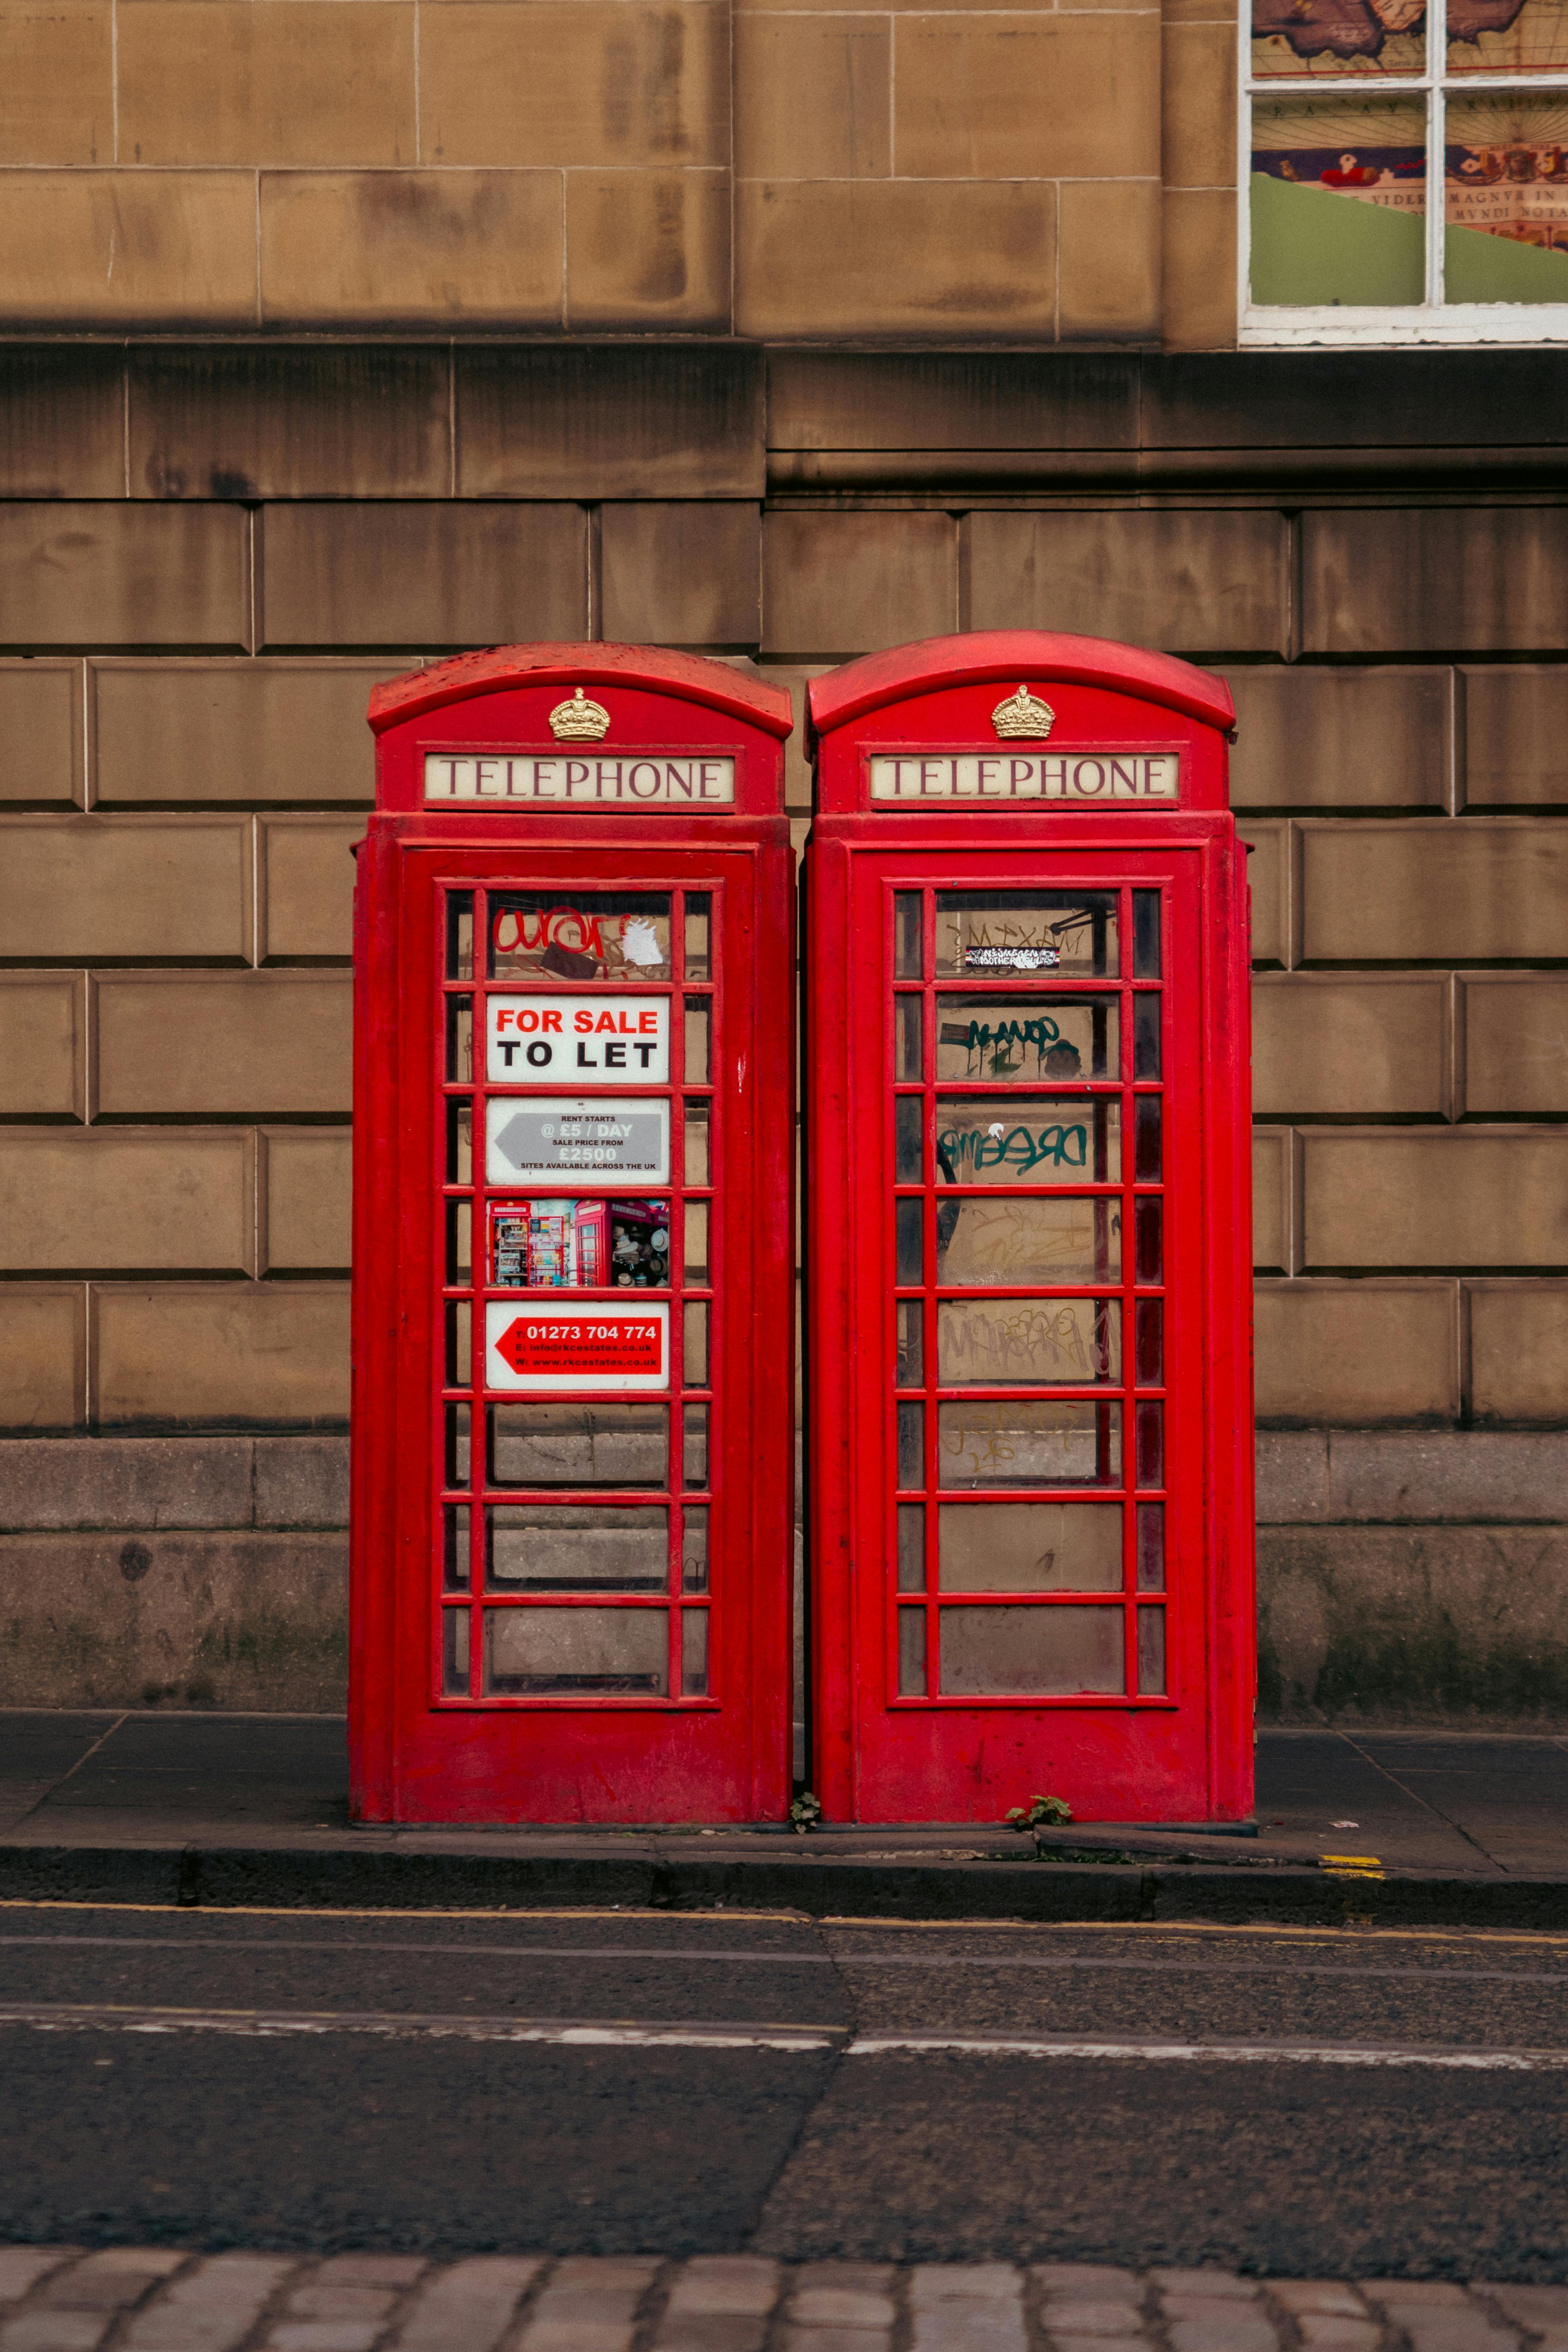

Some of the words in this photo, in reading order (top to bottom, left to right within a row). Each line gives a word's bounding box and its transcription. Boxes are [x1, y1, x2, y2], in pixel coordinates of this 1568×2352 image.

[439, 760, 722, 798] TELEPHONE
[883, 759, 1166, 795] TELEPHONE
[497, 1010, 563, 1032] FOR
[574, 1011, 658, 1034] SALE
[497, 1041, 553, 1067] TO
[577, 1042, 658, 1068] LET
[542, 1124, 555, 1138] @
[560, 1124, 582, 1137] £5
[587, 1124, 592, 1137] /
[597, 1124, 633, 1137] DAY
[559, 1148, 617, 1161] £2500
[527, 1326, 581, 1339] 01273
[587, 1326, 619, 1339] 704
[624, 1326, 656, 1339] 774
[530, 1344, 652, 1352] info@rkcestates.co.uk
